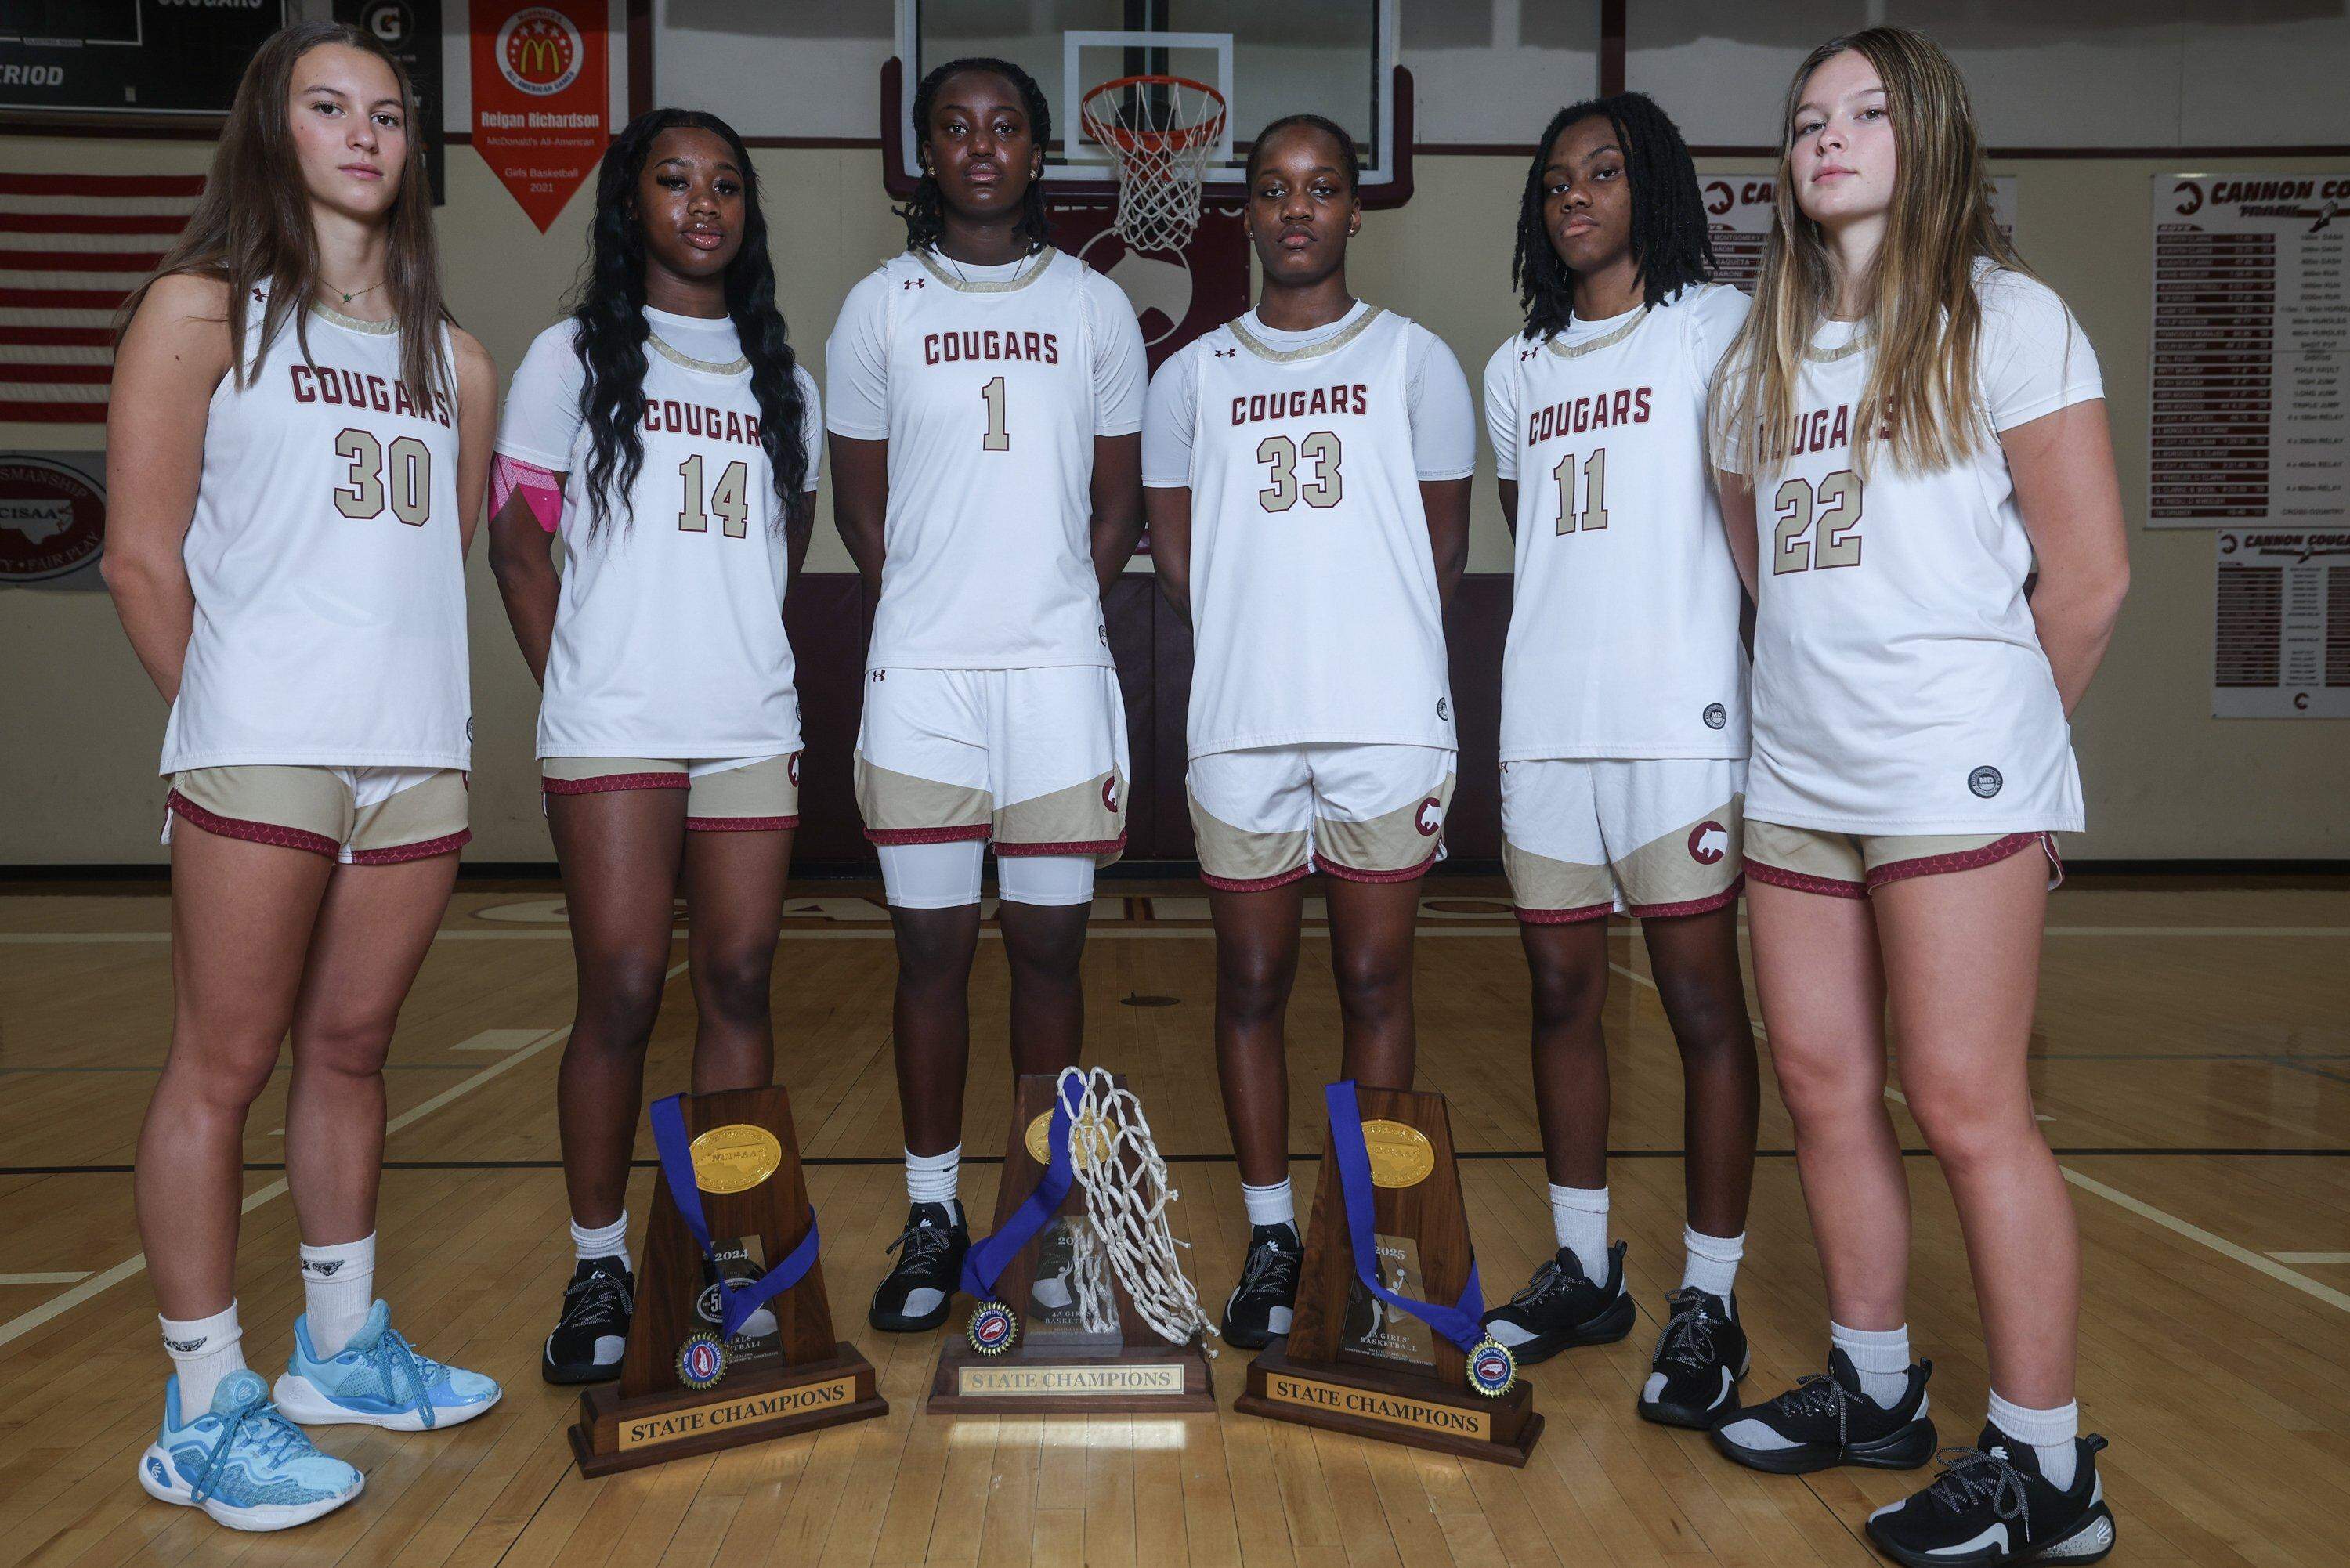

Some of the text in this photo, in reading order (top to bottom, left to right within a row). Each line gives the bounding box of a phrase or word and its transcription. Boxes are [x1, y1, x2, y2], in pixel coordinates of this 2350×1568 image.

[480, 110, 600, 130] Reigan Richardson
[486, 136, 595, 146] McDonald's All-American
[504, 168, 579, 179] Girls Basketball
[530, 182, 554, 193] 2021
[2211, 181, 2314, 205] CANNON
[924, 330, 1059, 367] COUGARS
[981, 376, 1010, 452] 1
[1231, 383, 1368, 427] COUGARS
[1528, 386, 1653, 447] COUGARS
[643, 399, 762, 448] COUGAR
[334, 427, 432, 528] 30
[1256, 430, 1343, 514] 33
[678, 453, 749, 540] 14
[1553, 447, 1609, 537] 11
[1773, 468, 1864, 576] 22
[27, 530, 101, 572] FAIR PLAY
[2244, 535, 2304, 548] CANNON
[714, 1248, 749, 1262] 2024
[1375, 1245, 1405, 1260] 2025
[974, 1310, 1004, 1331] CHAMPIONS
[730, 1334, 754, 1345] IRLS'
[732, 1339, 763, 1352] TBALL
[1379, 1331, 1411, 1343] GIRLS'
[707, 1342, 721, 1375] CHAMPIONS
[1476, 1348, 1507, 1363] CHAMPIONS
[971, 1371, 1171, 1389] STATE CHAMPIONS
[630, 1383, 845, 1443] STATE CHAMPIONS
[1276, 1380, 1480, 1434] STATE CHAMPIONS
